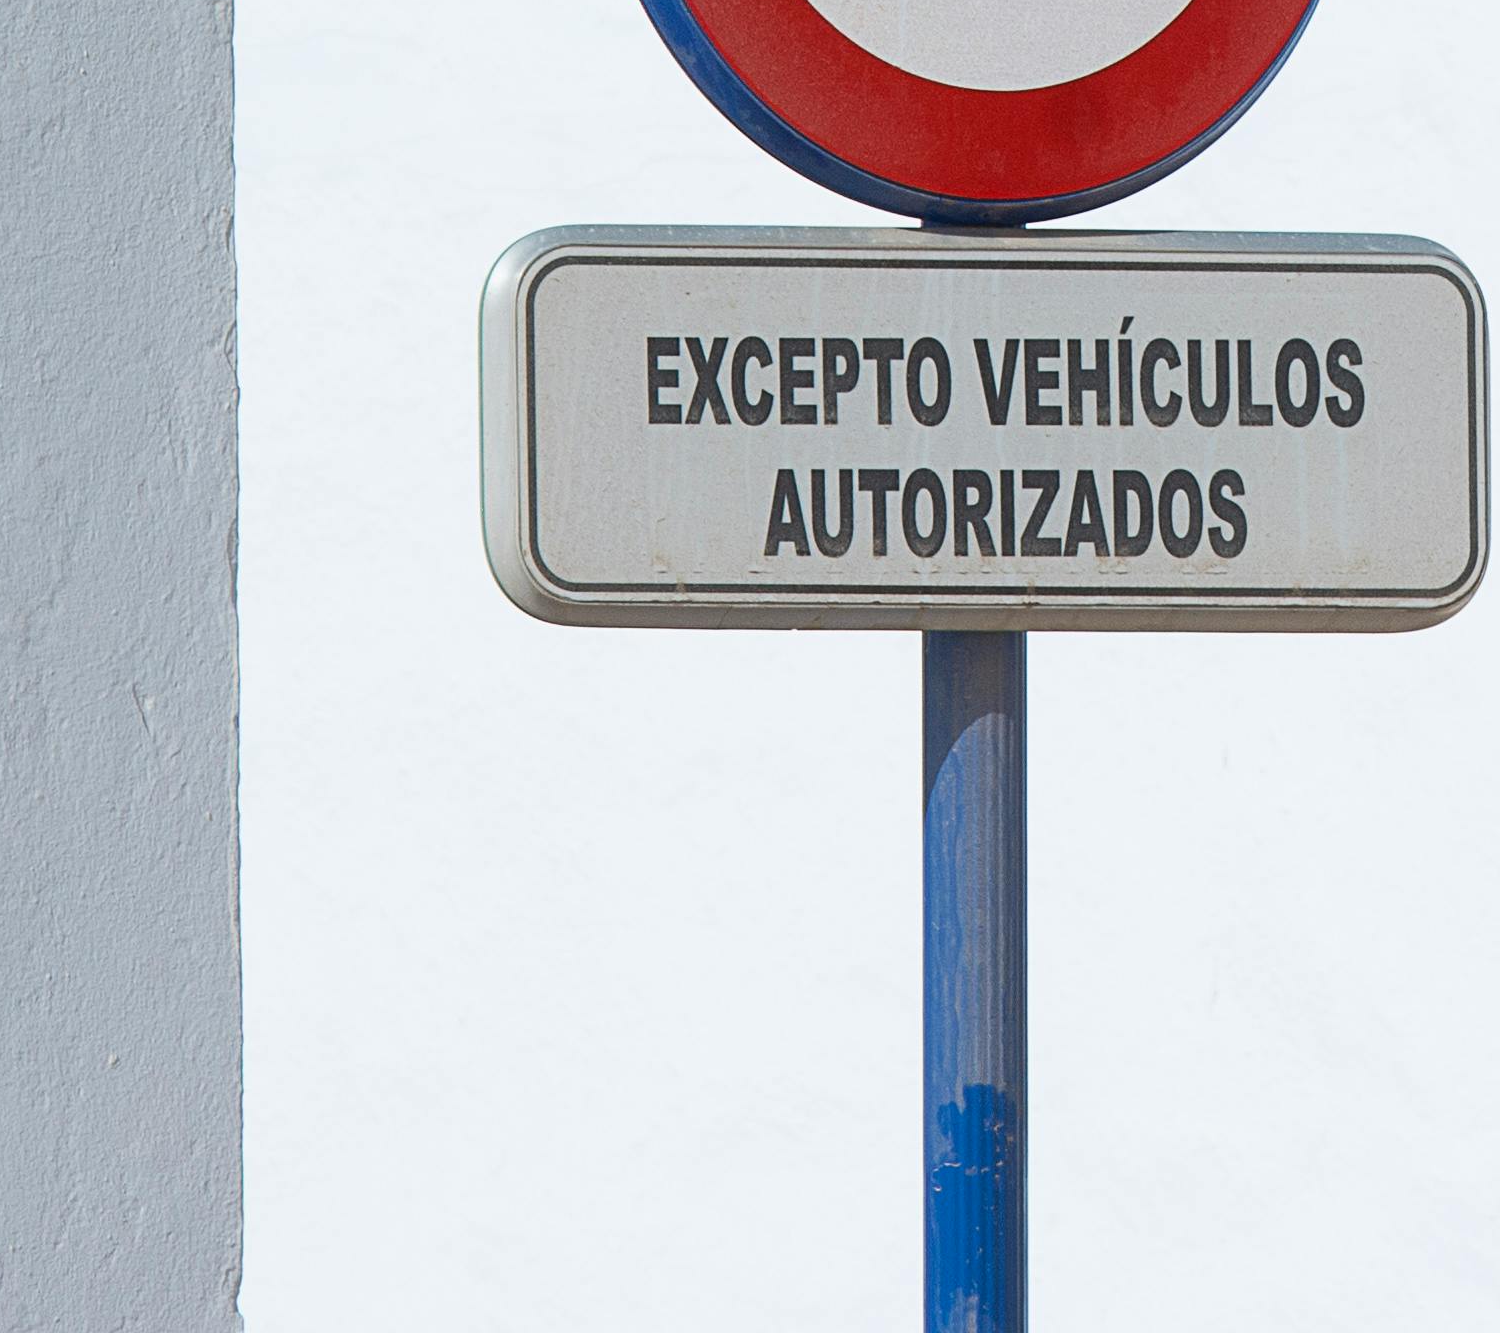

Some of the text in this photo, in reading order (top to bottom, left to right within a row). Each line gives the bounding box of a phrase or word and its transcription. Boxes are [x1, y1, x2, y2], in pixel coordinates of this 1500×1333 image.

[646, 315, 1366, 429] EXCEPTO VEHÍCULOS
[763, 467, 1248, 559] AUTORIZADOS
